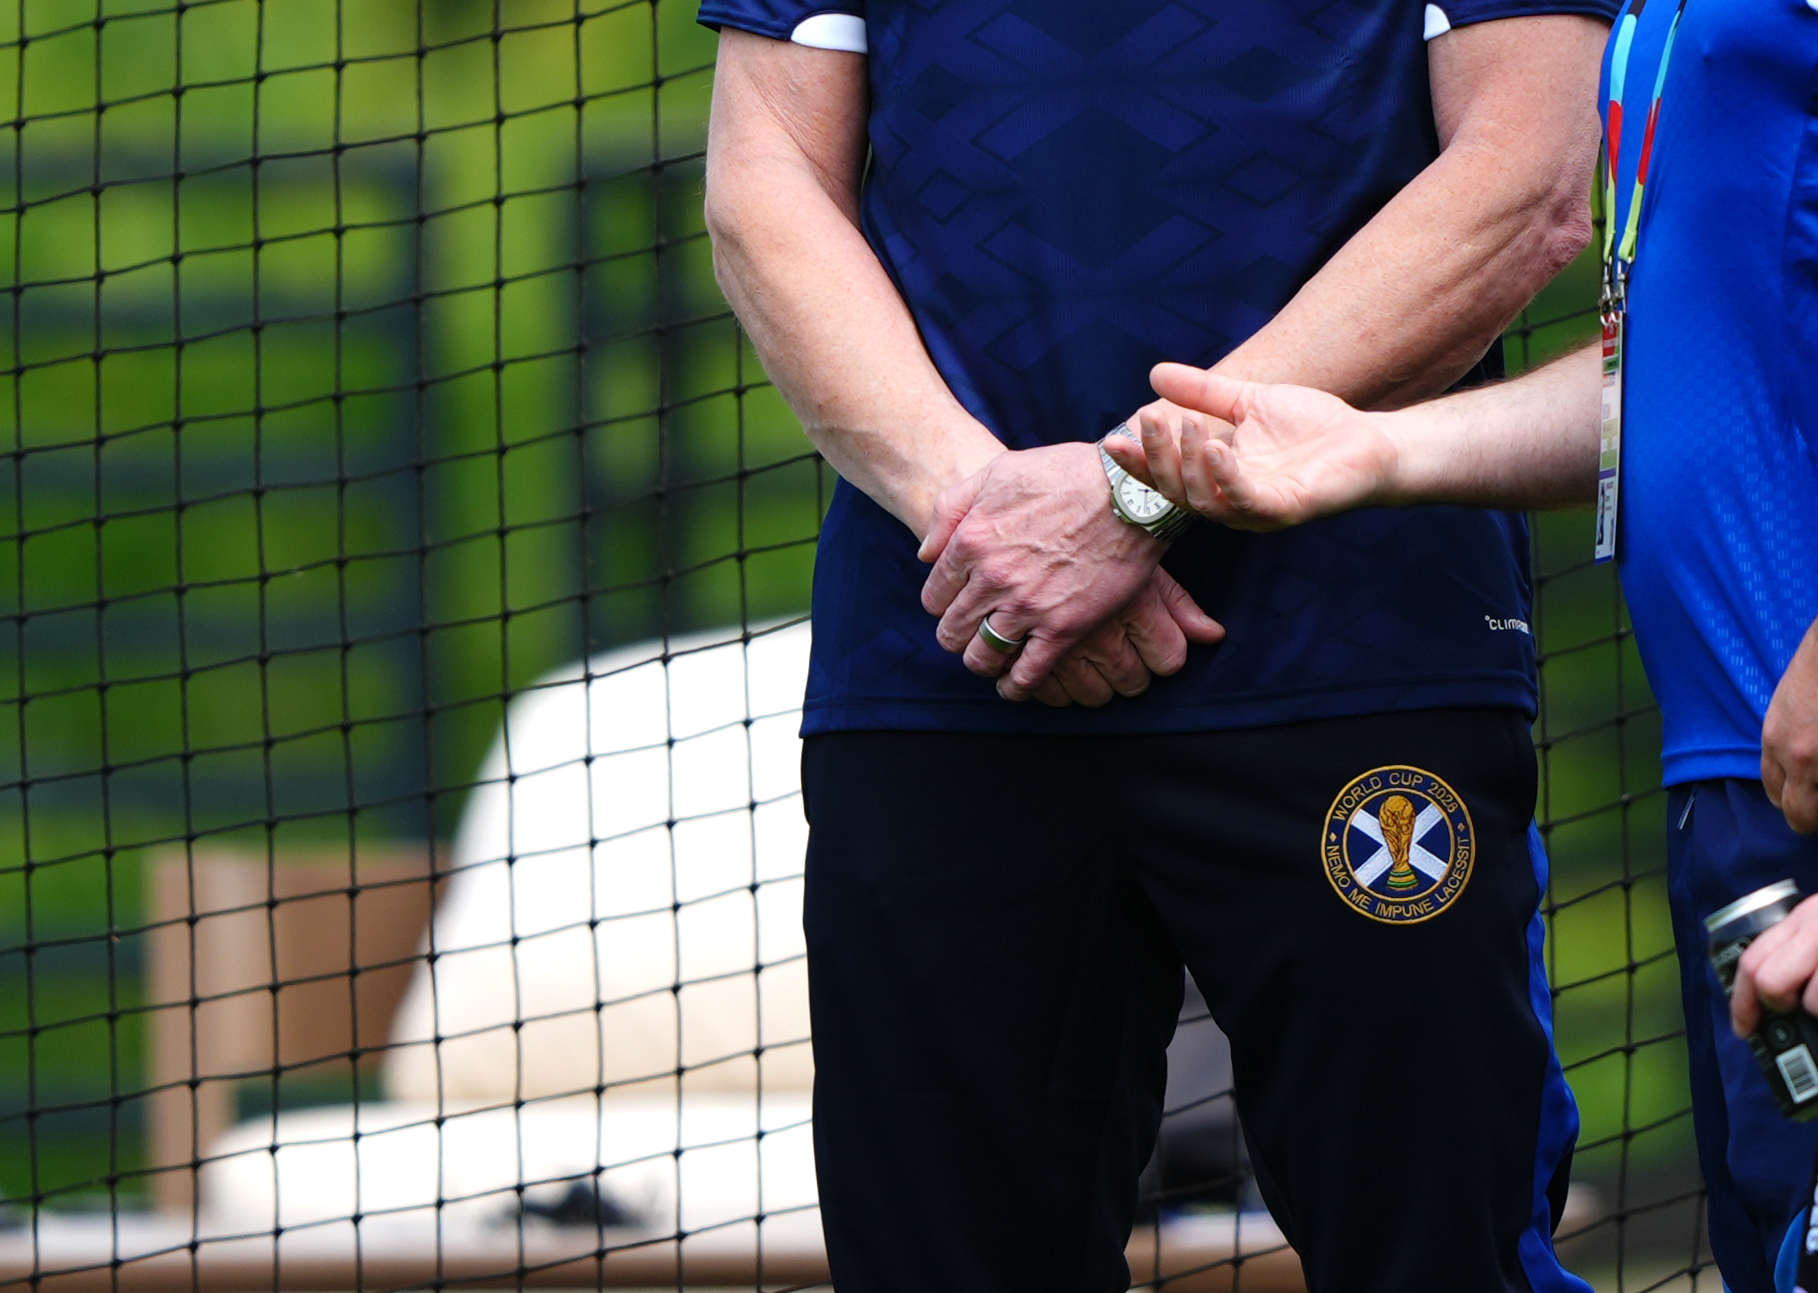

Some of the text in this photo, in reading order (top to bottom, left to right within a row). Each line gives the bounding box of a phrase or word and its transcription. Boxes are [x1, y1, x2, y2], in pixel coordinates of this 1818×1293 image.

[1332, 772, 1459, 822] WORLD CUP 2026
[1326, 836, 1470, 918] NEMO ME IMPUNE LACESSIT
